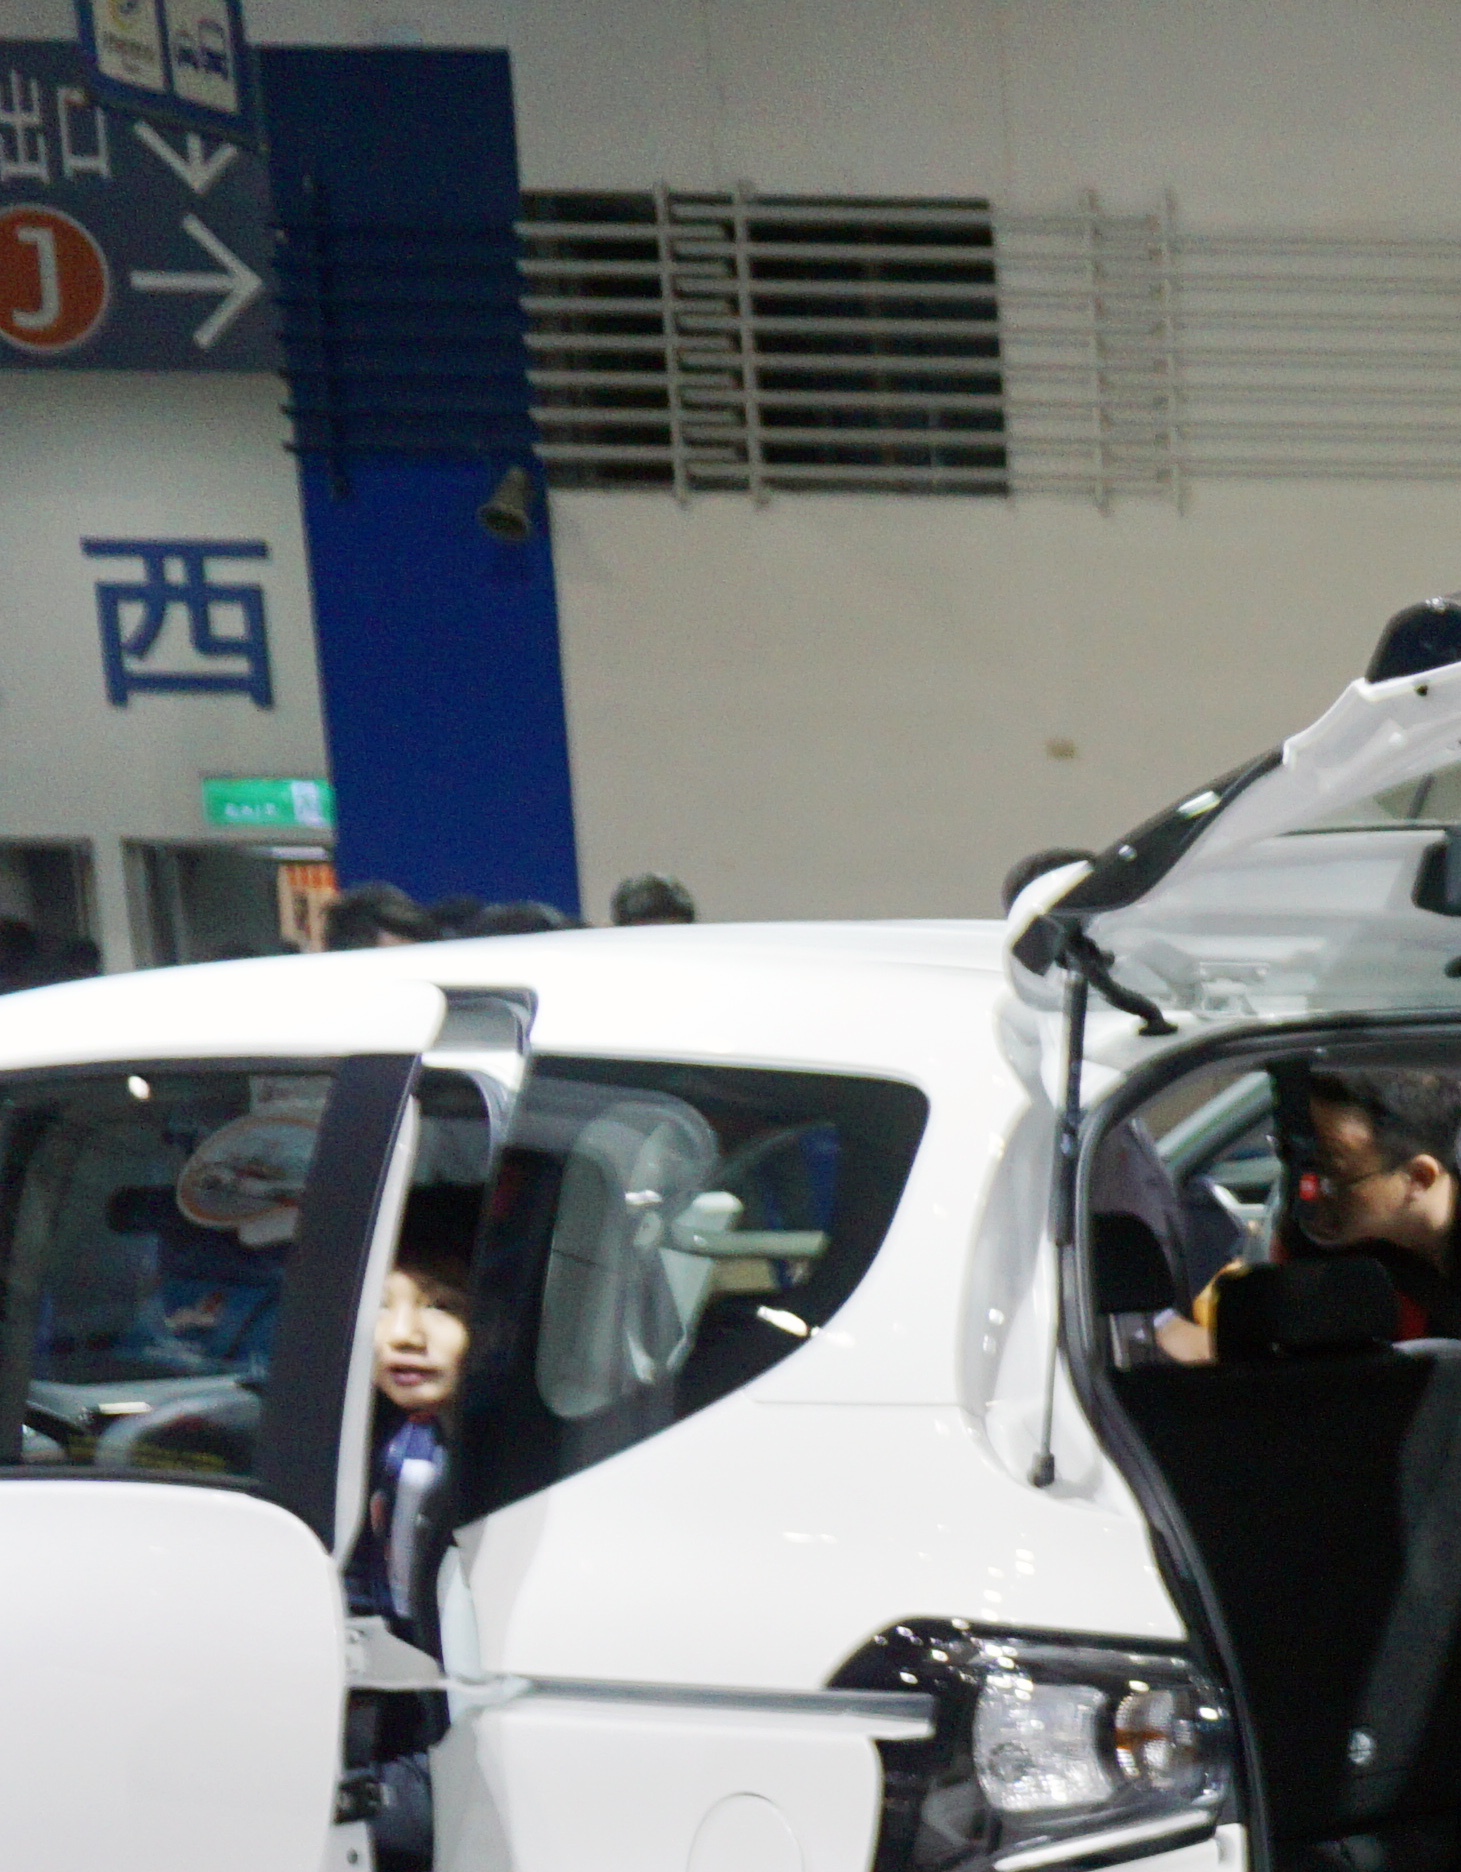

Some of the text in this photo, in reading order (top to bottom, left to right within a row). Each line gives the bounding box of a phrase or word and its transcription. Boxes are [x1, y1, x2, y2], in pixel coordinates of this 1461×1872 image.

[0, 68, 111, 184] 出口
[12, 225, 60, 330] J
[80, 536, 274, 710] 西
